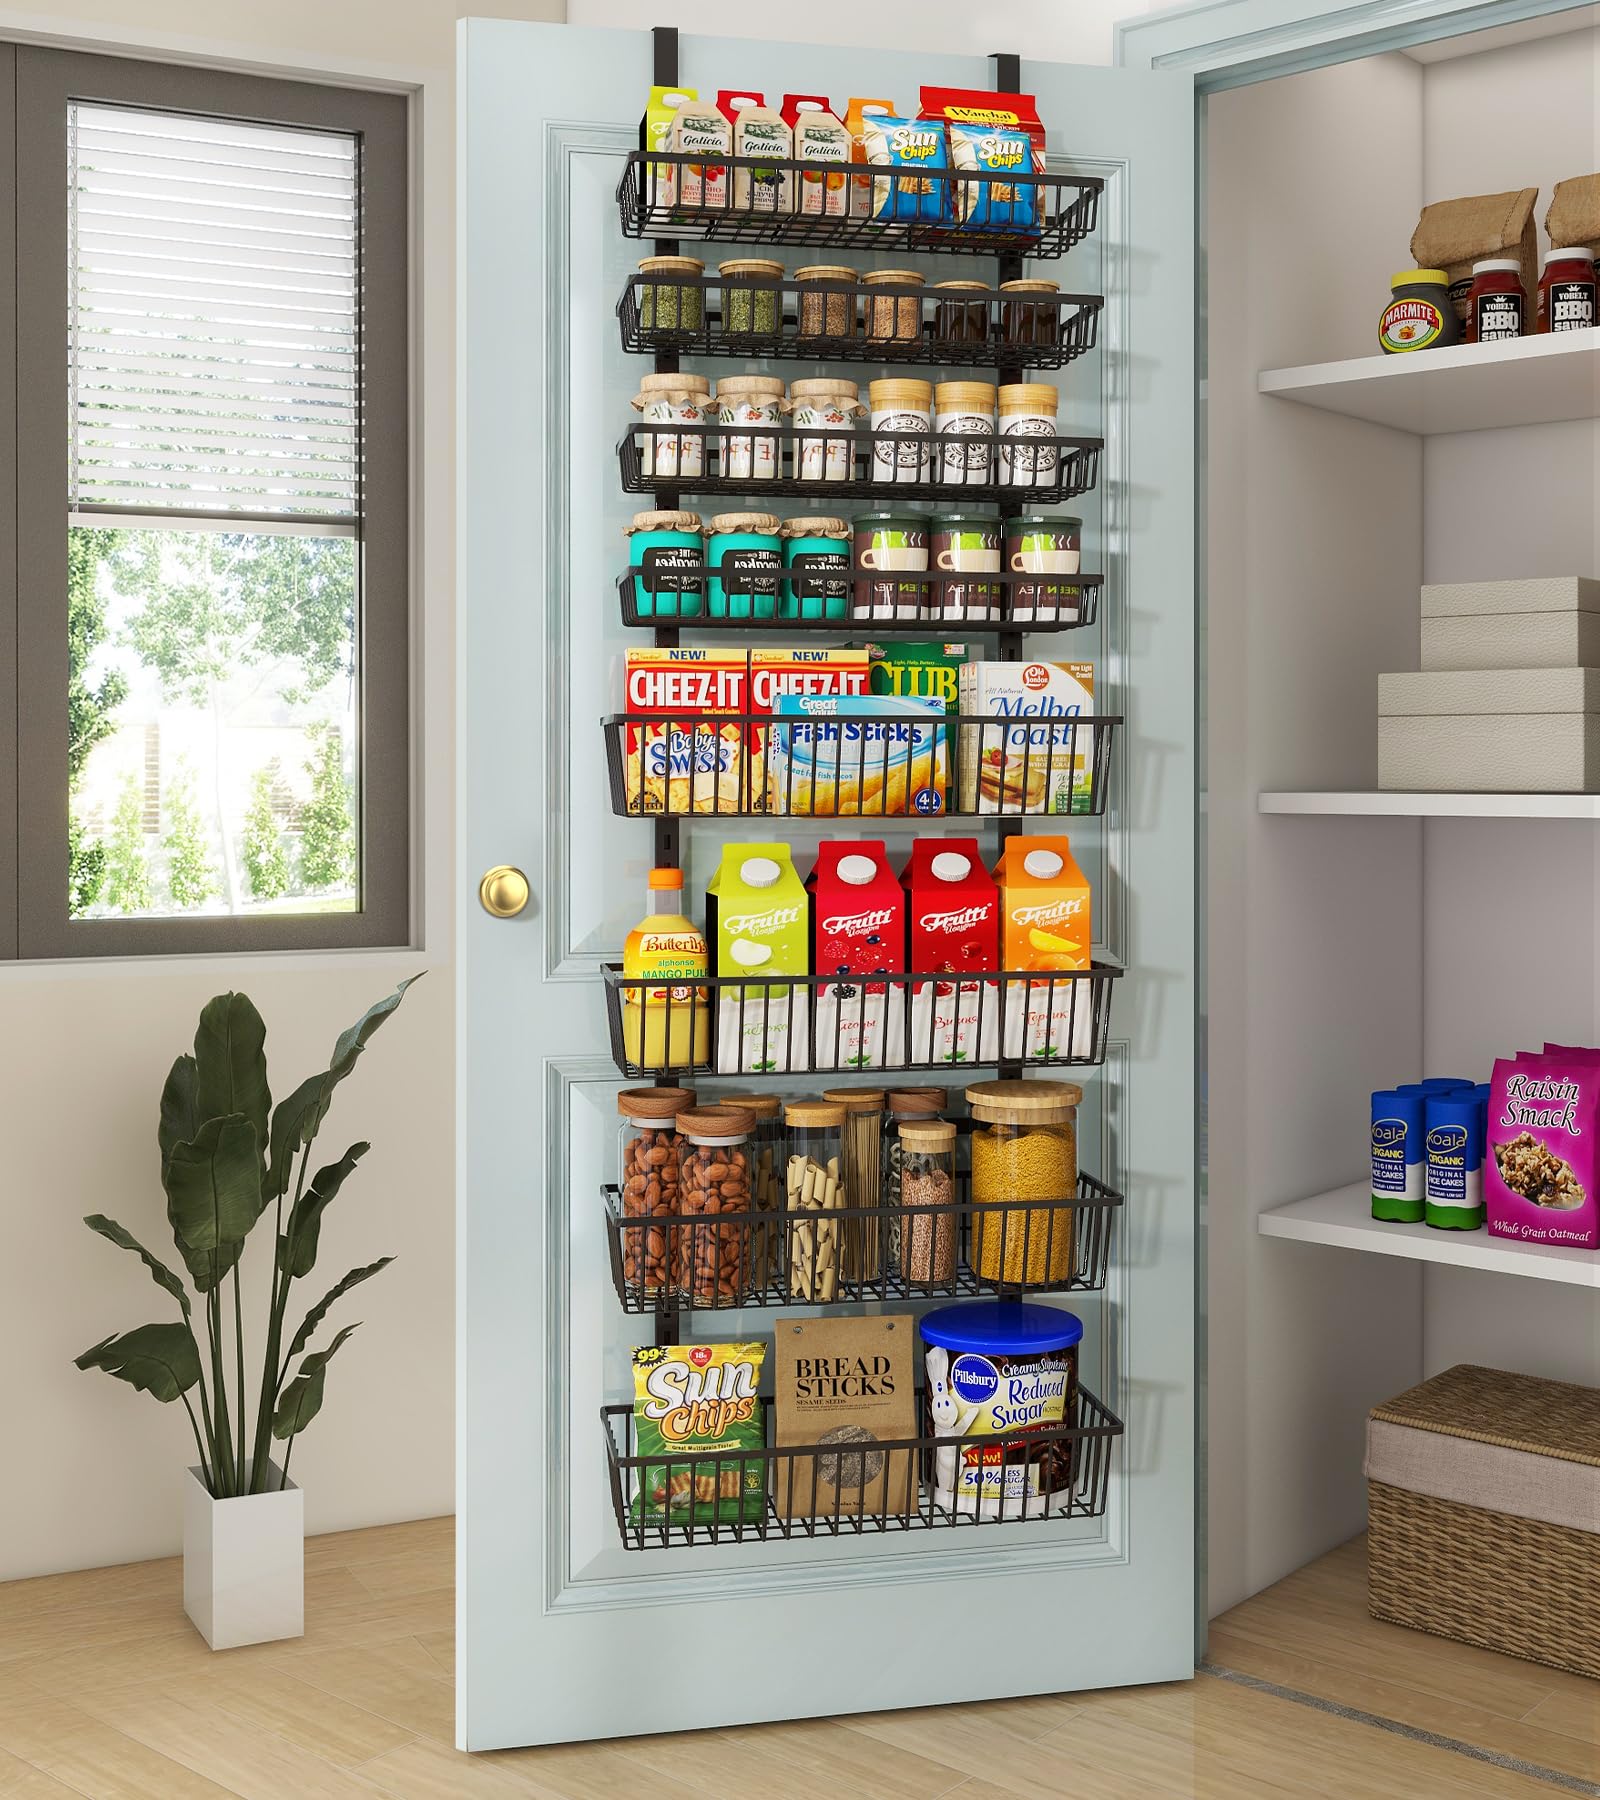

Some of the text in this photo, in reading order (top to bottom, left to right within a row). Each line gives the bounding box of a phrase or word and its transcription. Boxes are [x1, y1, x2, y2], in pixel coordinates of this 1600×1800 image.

[951, 108, 1012, 119] Wanchai
[684, 135, 725, 146] Galicia
[745, 141, 787, 153] Galicia
[891, 128, 938, 151] Sun
[978, 137, 1024, 160] Sun
[805, 145, 844, 156] Galicia
[900, 145, 936, 160] Chips
[987, 153, 1023, 168] Chips
[1385, 303, 1432, 326] MARMITE
[1554, 301, 1592, 321] BBQ
[1482, 311, 1519, 331] BBQ
[1554, 320, 1593, 331] sauce
[1482, 330, 1519, 341] sauce
[669, 650, 706, 660] NEW!
[792, 651, 829, 661] NEW!
[1030, 666, 1045, 677] Old
[629, 669, 744, 707] CHEEZ-IT
[799, 697, 838, 710] Great
[792, 722, 839, 744] Fish
[845, 722, 923, 743] Sticks
[724, 904, 803, 934] Frutti
[920, 903, 992, 932] Frutti
[1011, 896, 1086, 925] Frutti
[822, 906, 896, 934] Frutti
[658, 960, 695, 968] alphonso
[642, 970, 682, 979] MANGO
[1507, 1074, 1579, 1102] Raisin
[1500, 1100, 1581, 1135] Smack
[1429, 1154, 1464, 1165] ORGANIC
[1381, 1171, 1404, 1180] CAKES
[1429, 1168, 1464, 1178] ORIGINAL
[1440, 1178, 1464, 1187] CAKES
[1493, 1220, 1592, 1242] Whole Grain Oatmeal
[794, 1356, 890, 1378] BREAD
[1002, 1362, 1040, 1378] Creamy
[796, 1375, 895, 1398] STICKS
[954, 1368, 996, 1388] Pillsbury
[645, 1361, 757, 1419] Sun
[1009, 1376, 1065, 1405] Reduced
[661, 1398, 754, 1440] Chips
[991, 1400, 1047, 1430] Sugar
[967, 1452, 1001, 1464] New!
[1007, 1469, 1021, 1477] ESS
